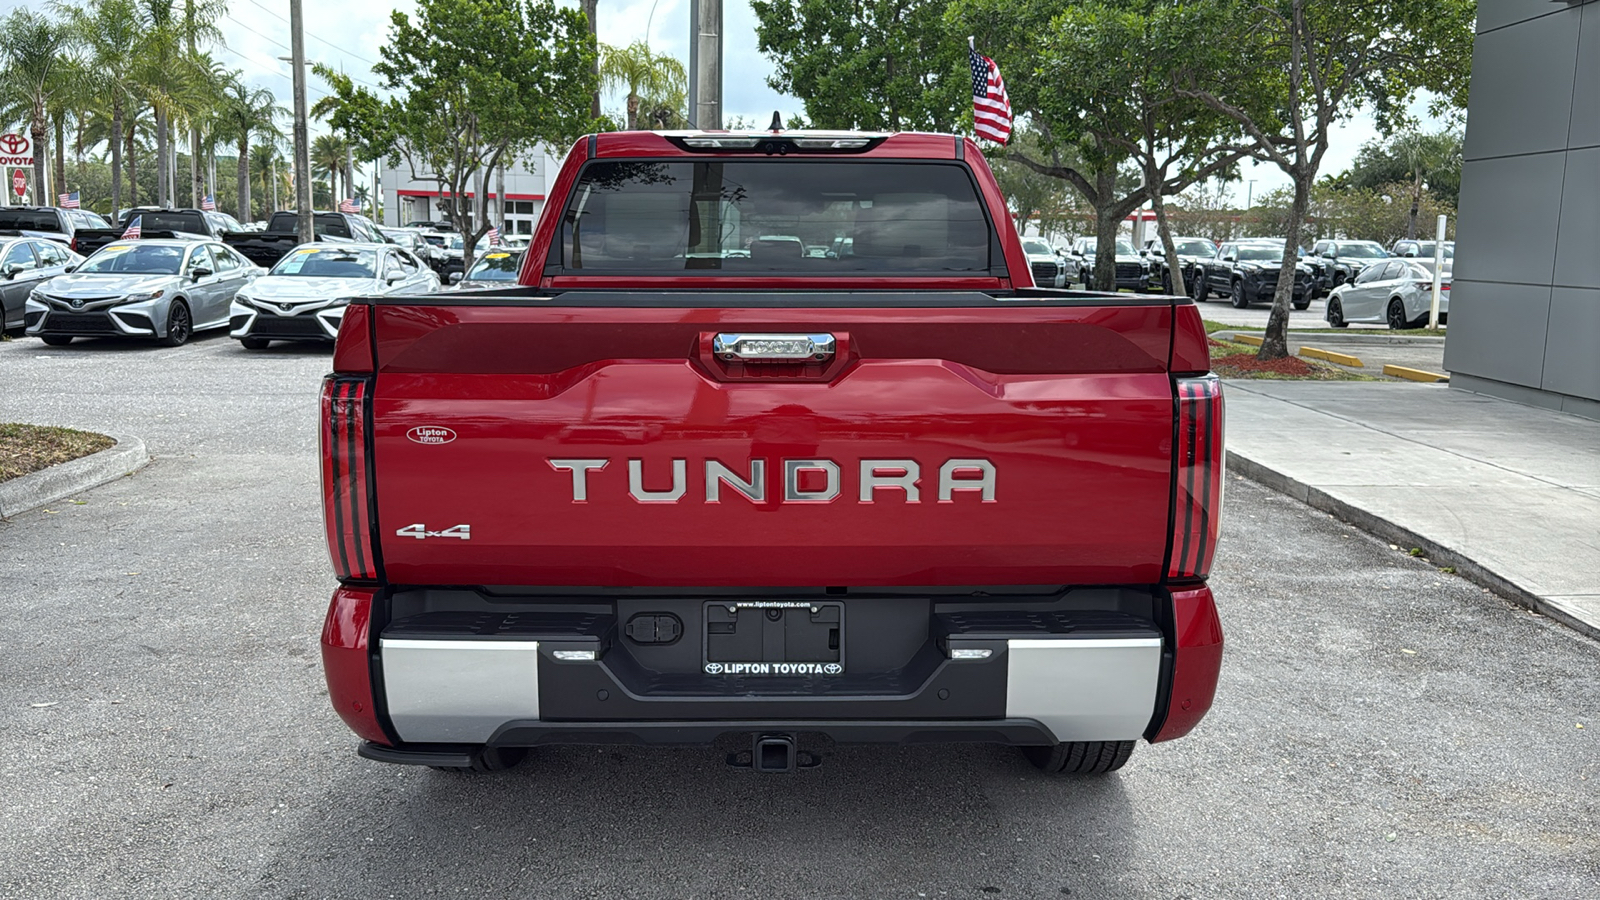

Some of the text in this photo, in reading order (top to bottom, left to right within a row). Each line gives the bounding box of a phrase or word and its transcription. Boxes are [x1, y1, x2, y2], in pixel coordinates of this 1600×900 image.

[0, 156, 35, 165] OYOTA
[14, 177, 26, 188] STOP
[747, 341, 803, 353] TOYOTA
[416, 428, 448, 438] Lipton
[547, 458, 998, 504] TUNDRA
[736, 601, 811, 609] www.liptontoyota.com
[724, 663, 824, 675] LIPTON TOYOTA
